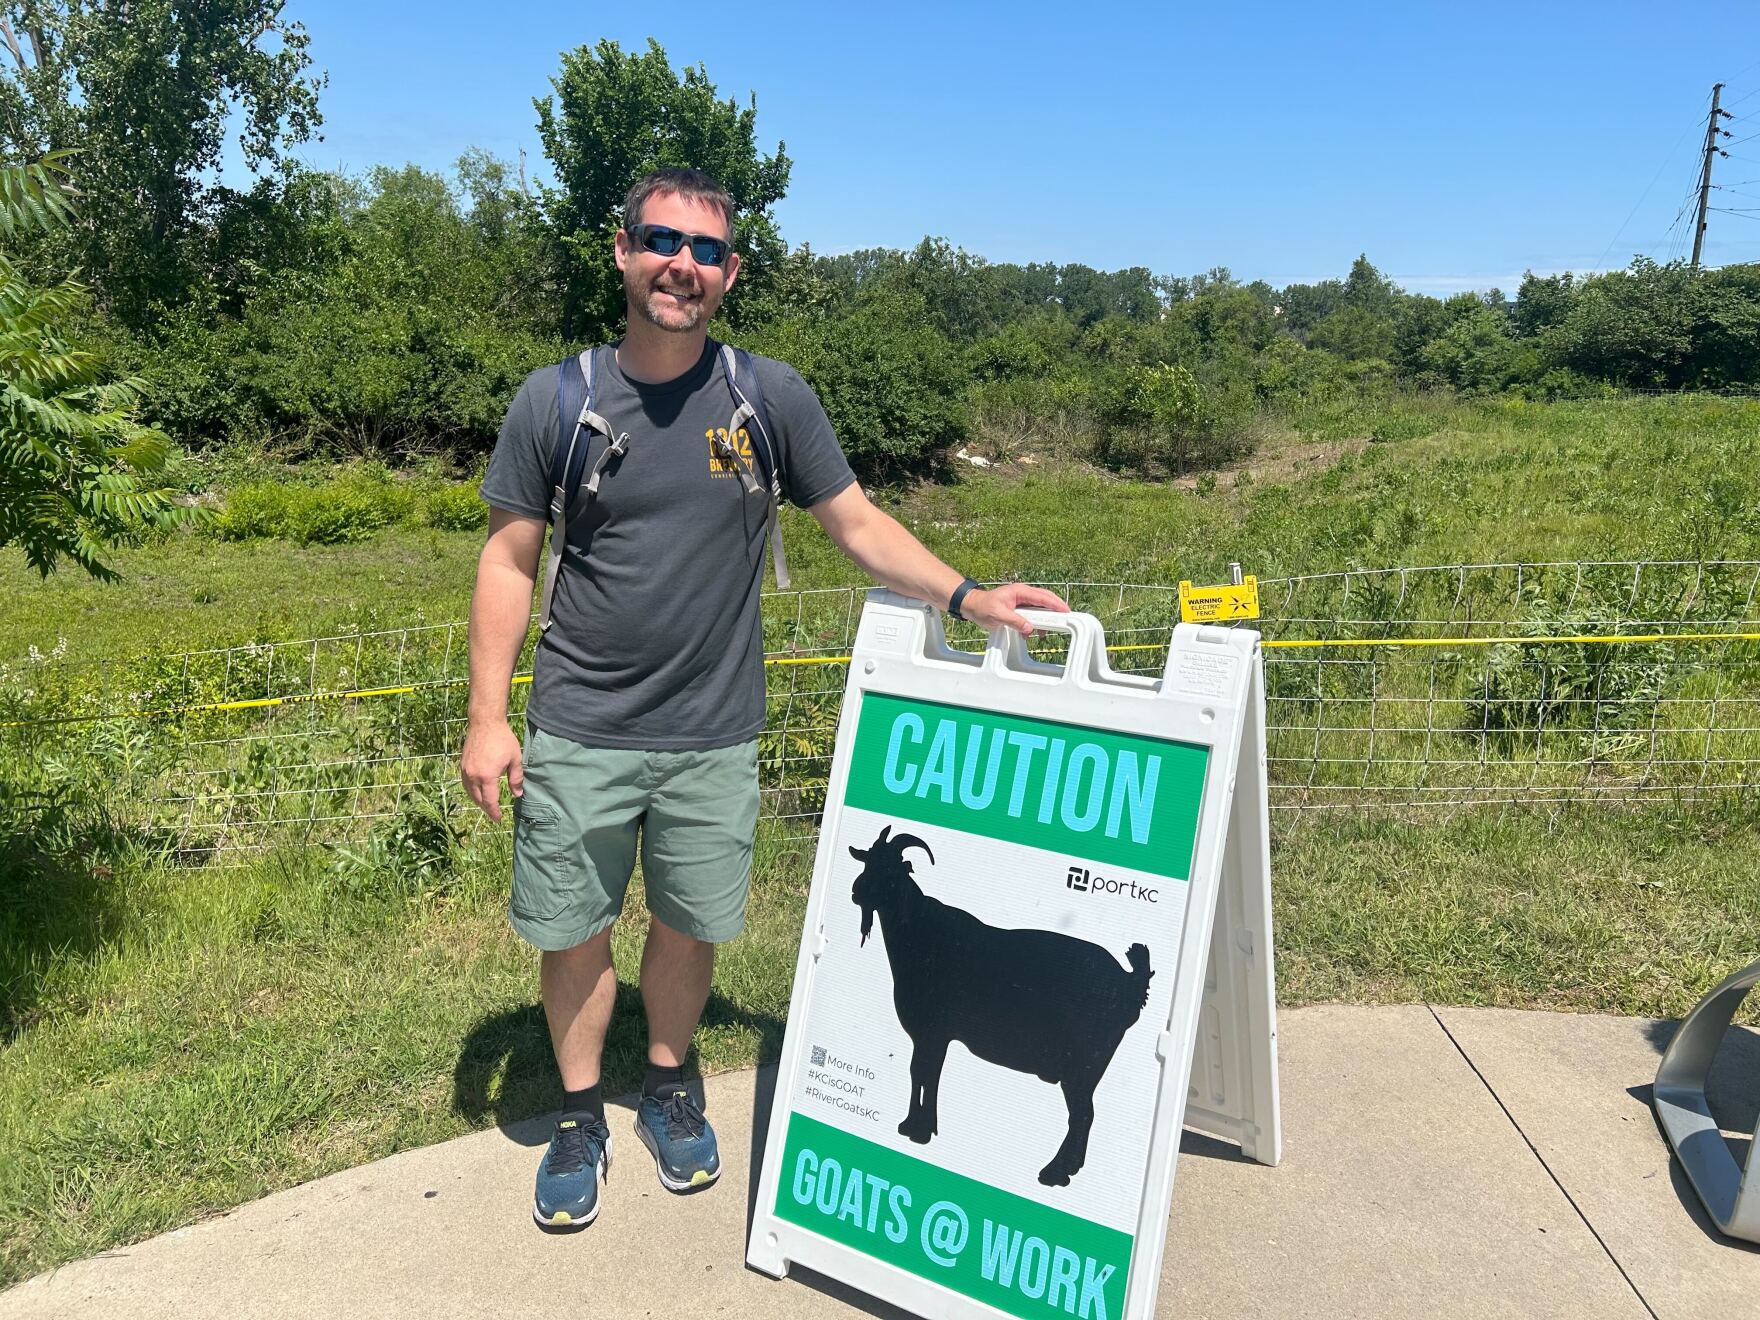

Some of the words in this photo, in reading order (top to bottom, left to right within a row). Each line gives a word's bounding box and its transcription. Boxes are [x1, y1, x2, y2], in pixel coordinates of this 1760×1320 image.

[1188, 597, 1223, 605] WARNING
[1191, 603, 1221, 611] ELECTRIC
[883, 712, 1162, 845] CAUTION
[827, 1055, 853, 1072] More
[855, 1065, 875, 1080] Info
[808, 1069, 865, 1098] #KCisGOAT
[805, 1085, 880, 1122] #RiverGoatsKC
[792, 1148, 912, 1244] GOATS
[920, 1200, 969, 1267] @
[981, 1218, 1117, 1320] WORK
